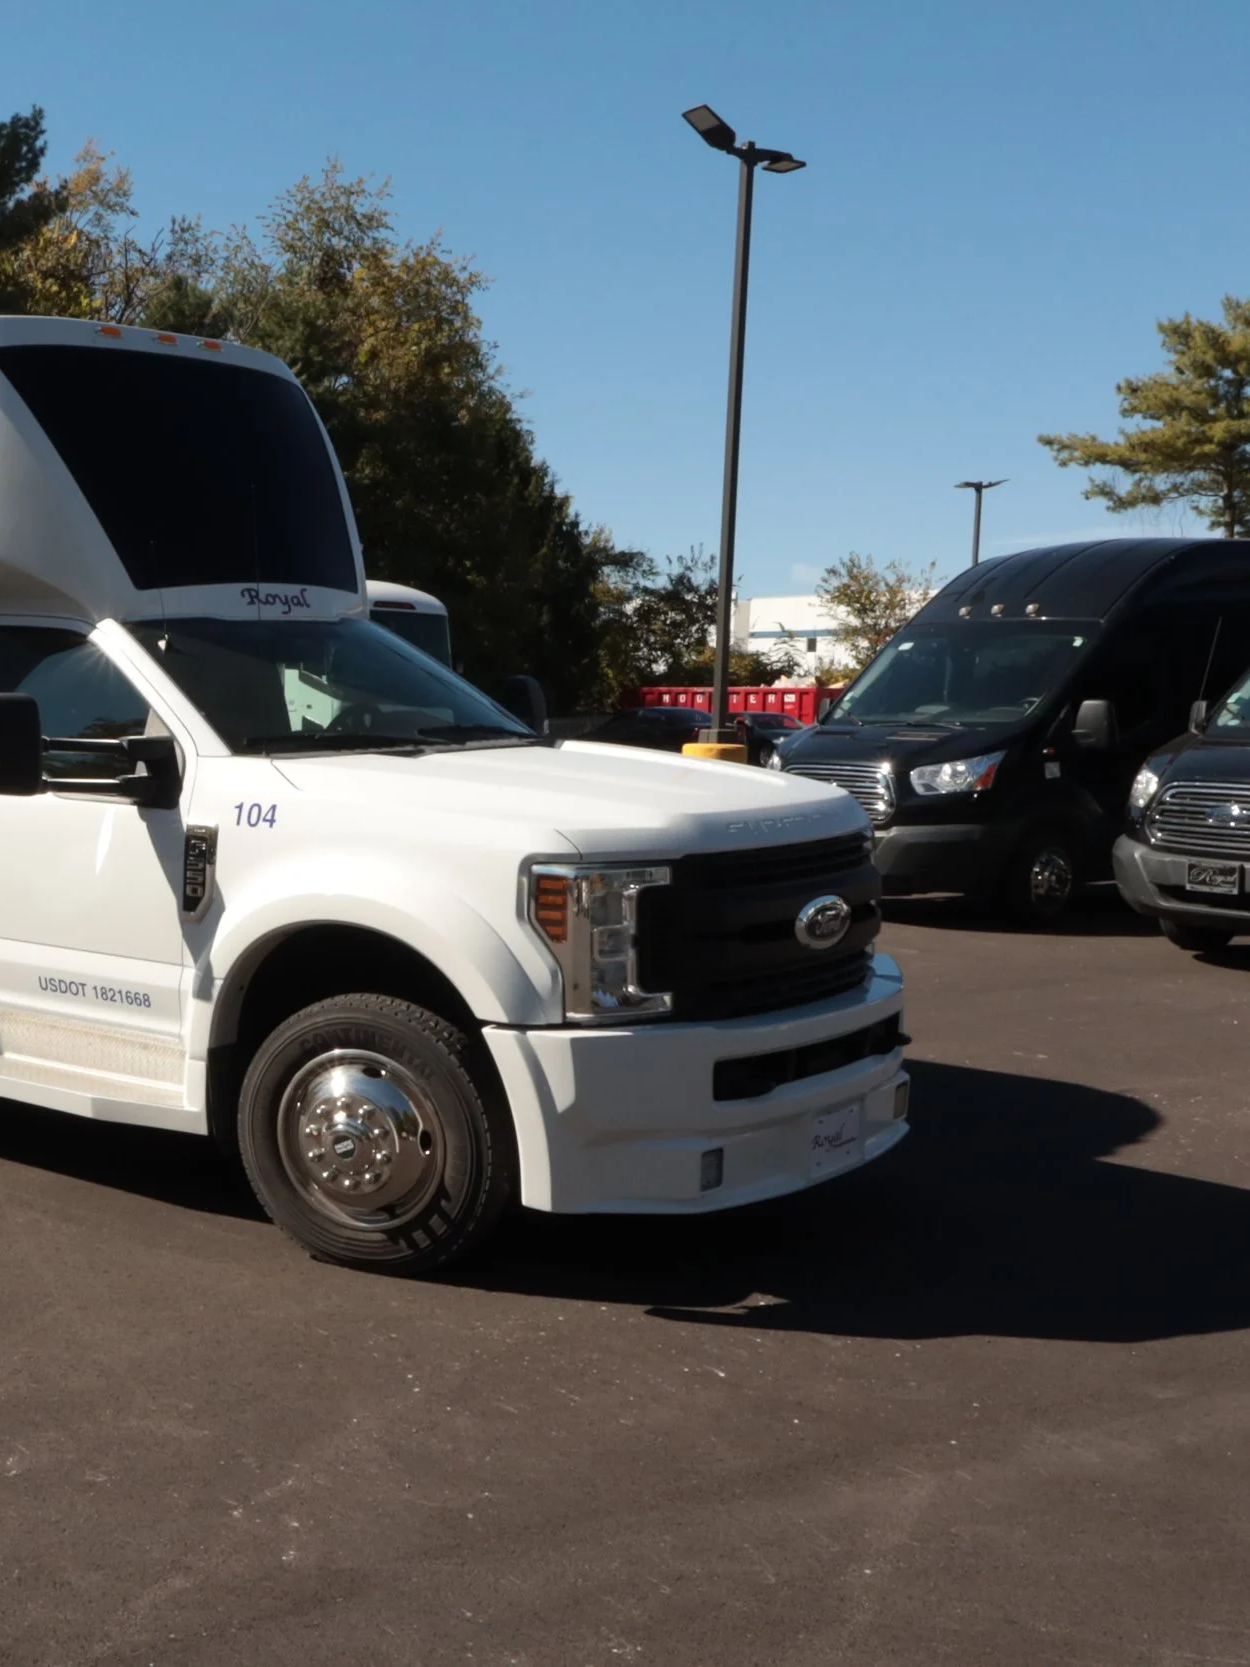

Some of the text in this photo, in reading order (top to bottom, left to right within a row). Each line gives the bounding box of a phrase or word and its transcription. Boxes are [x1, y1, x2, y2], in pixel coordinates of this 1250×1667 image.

[240, 587, 311, 615] Royal
[662, 694, 776, 704] HOOIER
[234, 801, 278, 829] 104
[38, 976, 152, 1009] USDOT 1821668
